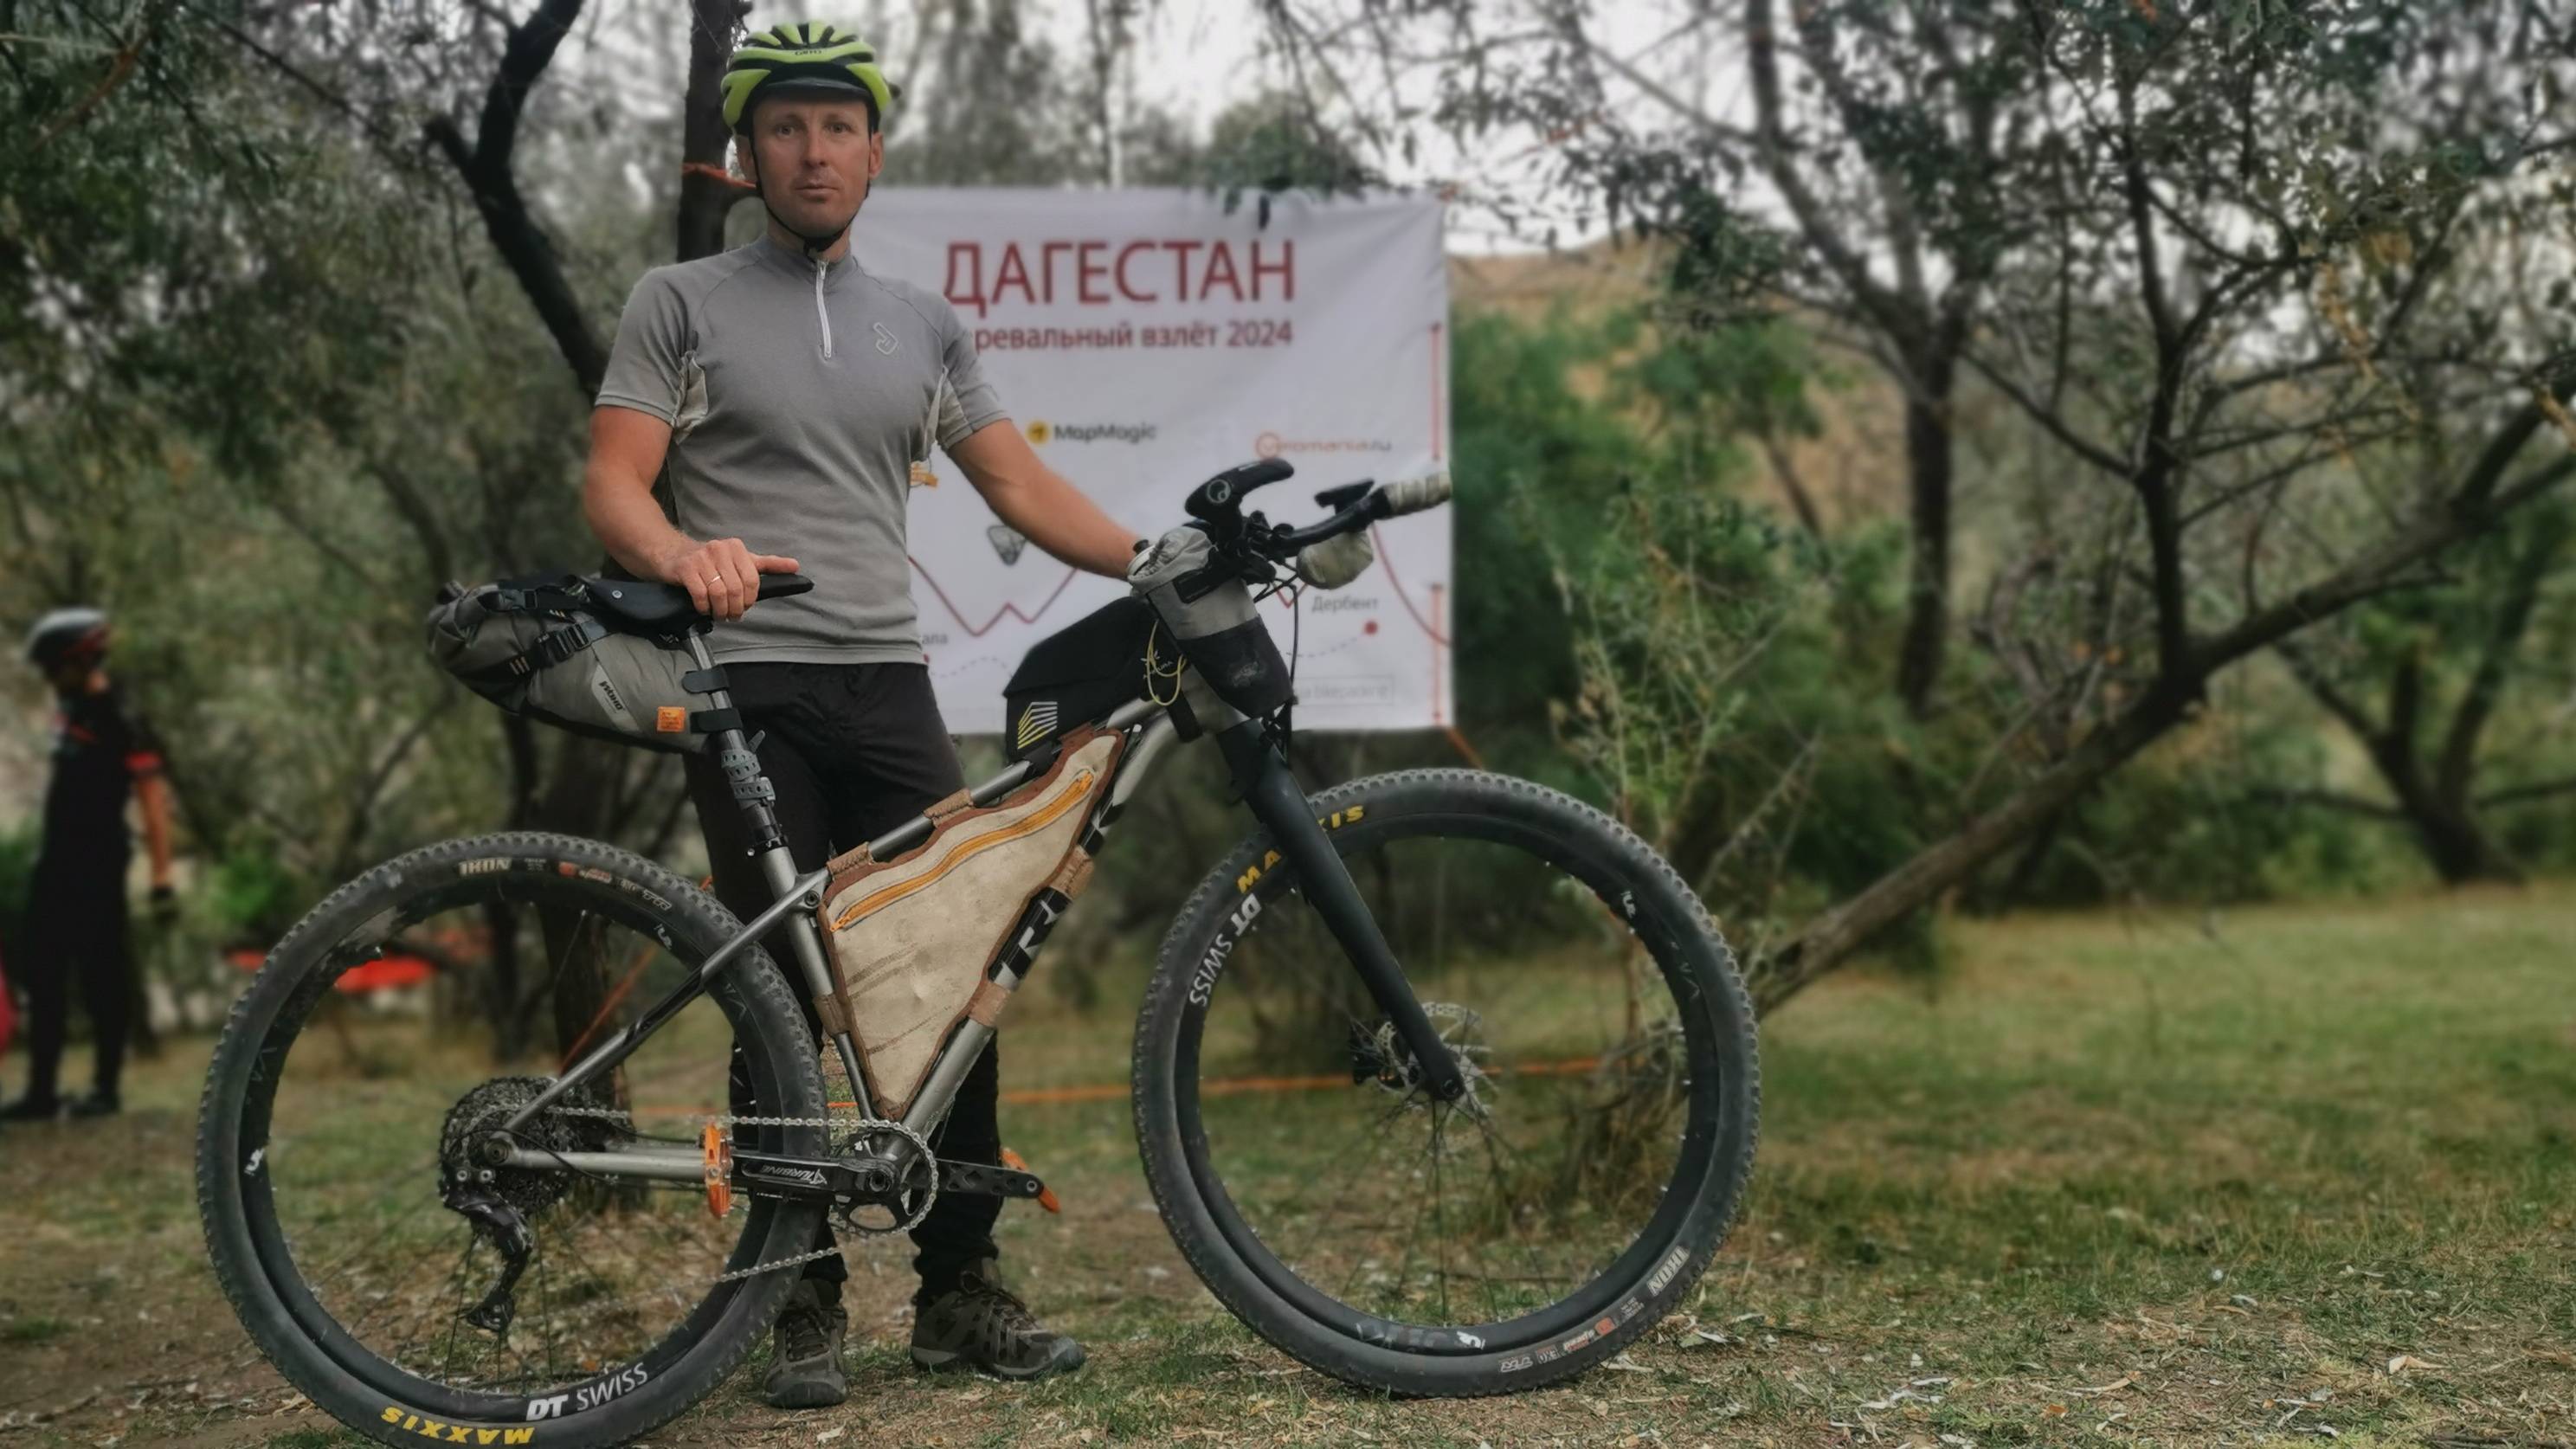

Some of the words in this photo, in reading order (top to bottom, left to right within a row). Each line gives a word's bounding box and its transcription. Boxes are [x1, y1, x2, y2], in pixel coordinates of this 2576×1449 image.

[943, 239, 1297, 319] ДАГЕСТАН
[1140, 321, 1217, 347] взлёт
[1227, 320, 1293, 348] 2024
[1311, 595, 1378, 614] Дербент
[1230, 892, 1263, 937] DT
[1188, 932, 1233, 1008] SWISS
[525, 1394, 570, 1422] DT
[576, 1362, 649, 1411] SWISS
[381, 1406, 535, 1445] MAXXIS
